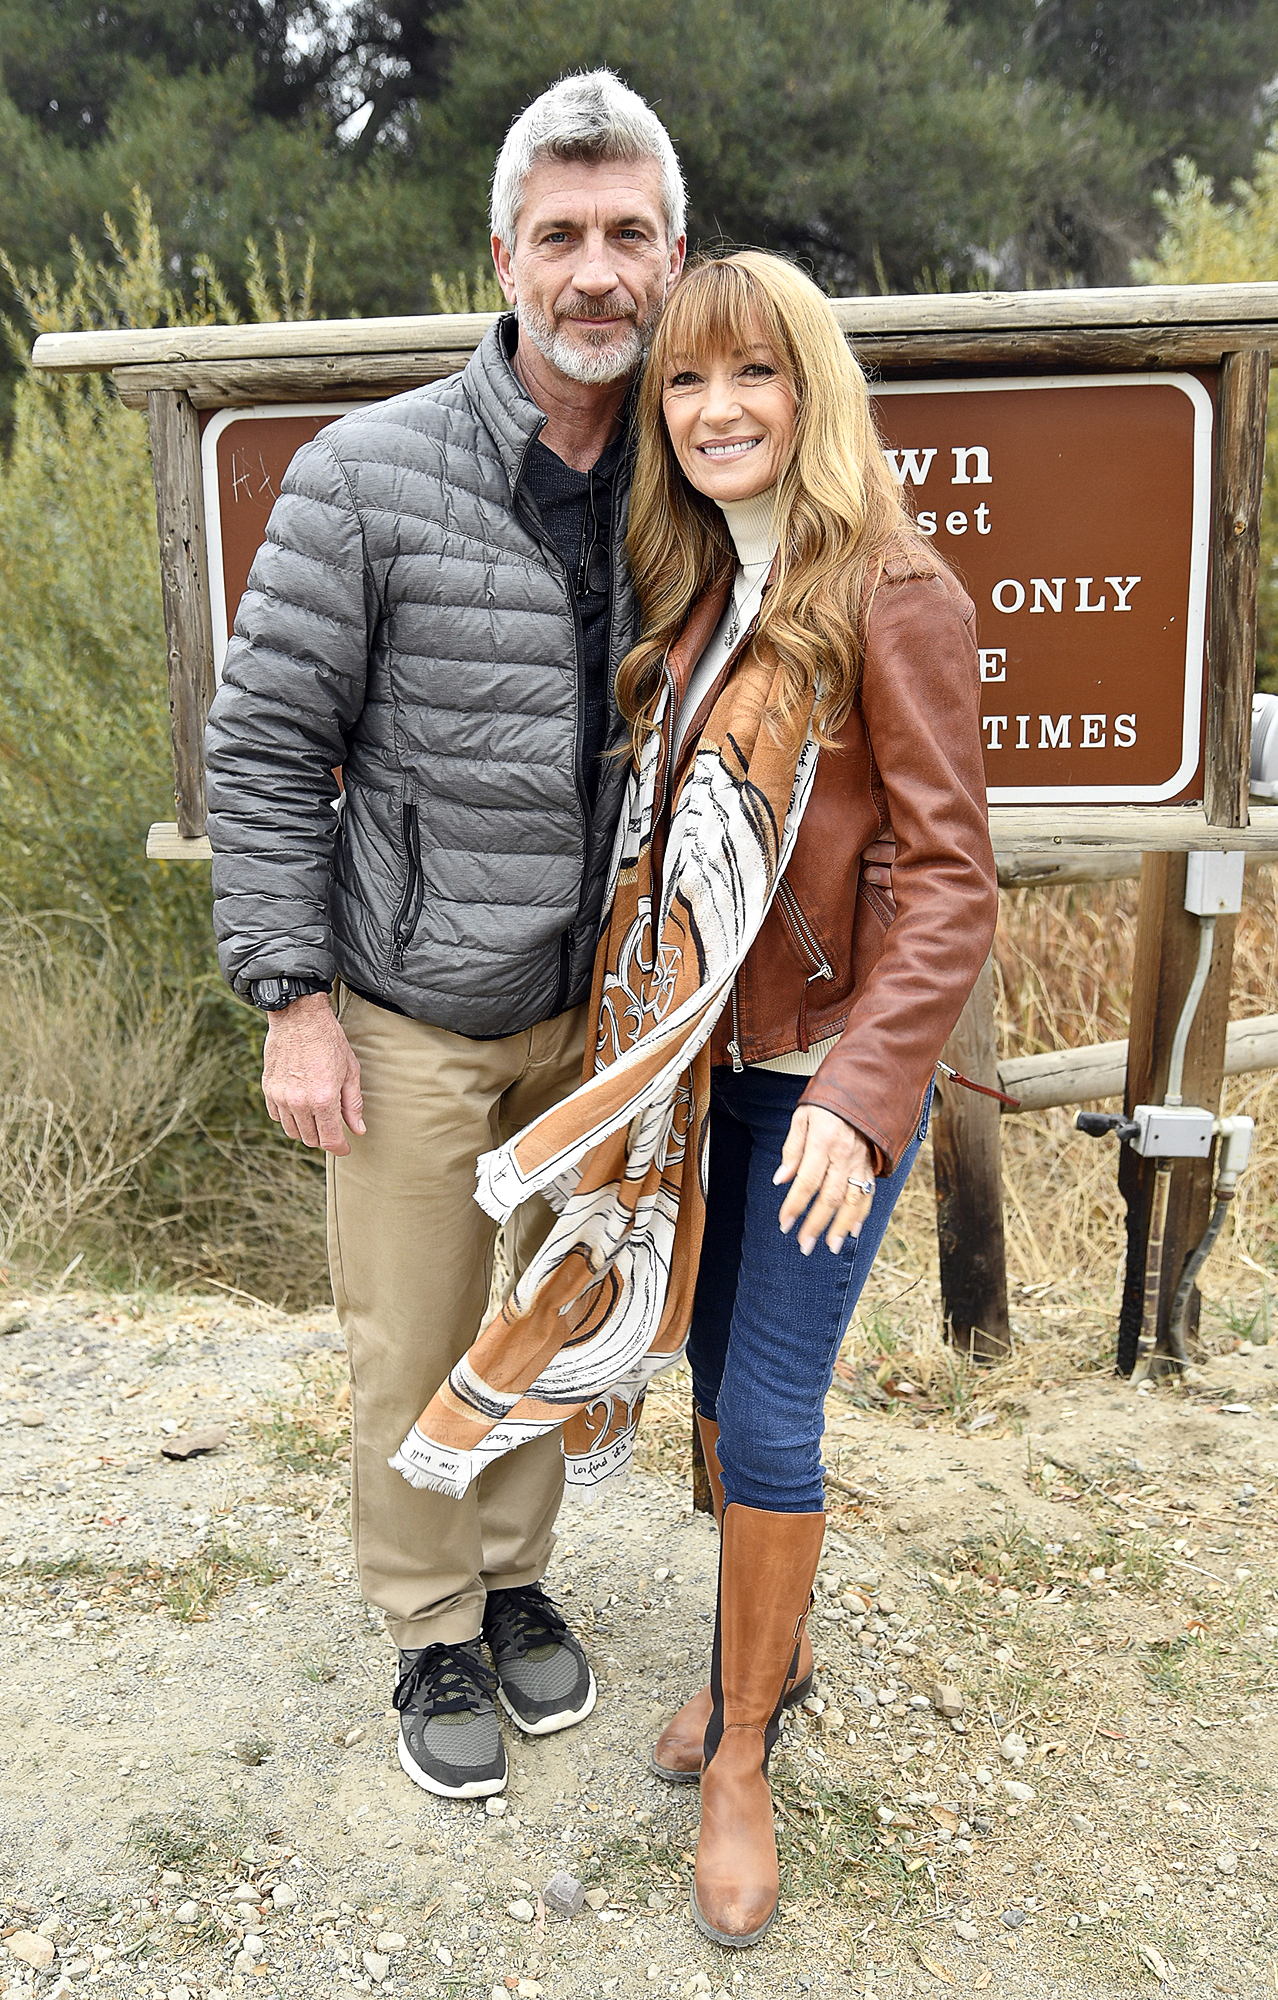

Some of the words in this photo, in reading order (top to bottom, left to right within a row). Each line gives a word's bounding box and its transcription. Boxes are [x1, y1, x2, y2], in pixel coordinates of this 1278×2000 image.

[882, 446, 993, 486] wn
[916, 502, 992, 536] set
[991, 576, 1142, 614] ONLY
[978, 648, 1007, 682] E
[982, 713, 1137, 749] TIMES
[794, 773, 803, 784] is
